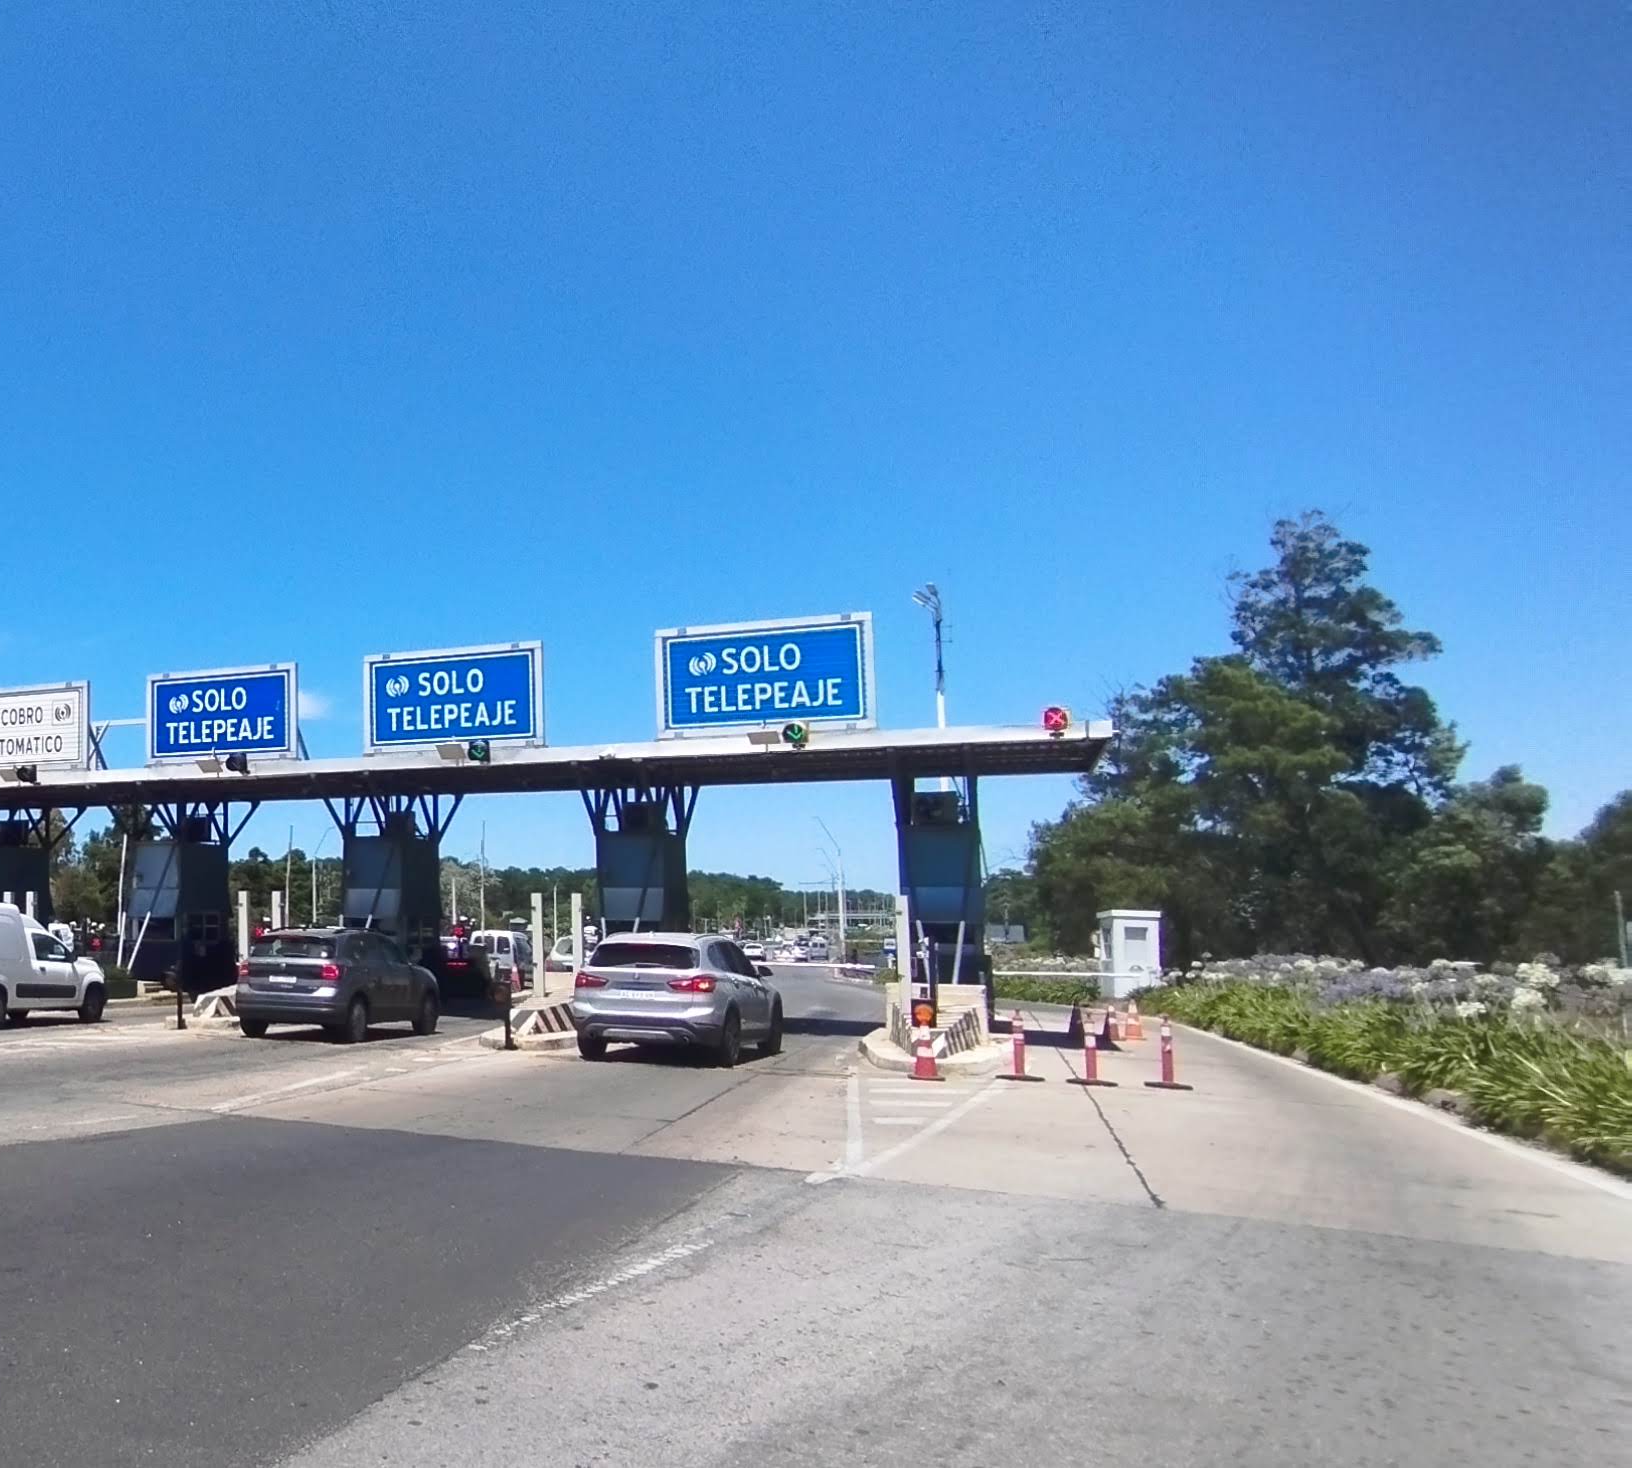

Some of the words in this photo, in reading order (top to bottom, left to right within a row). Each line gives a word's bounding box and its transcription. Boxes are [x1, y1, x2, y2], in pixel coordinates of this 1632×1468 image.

[721, 643, 801, 674] SOLO
[418, 668, 484, 696] SOLO
[685, 678, 842, 713] TELEPEAJE
[192, 687, 247, 713] SOLO
[0, 706, 44, 726] COBRO
[166, 716, 275, 745] TELEPEAJE
[387, 700, 517, 732] TELEPEAJE
